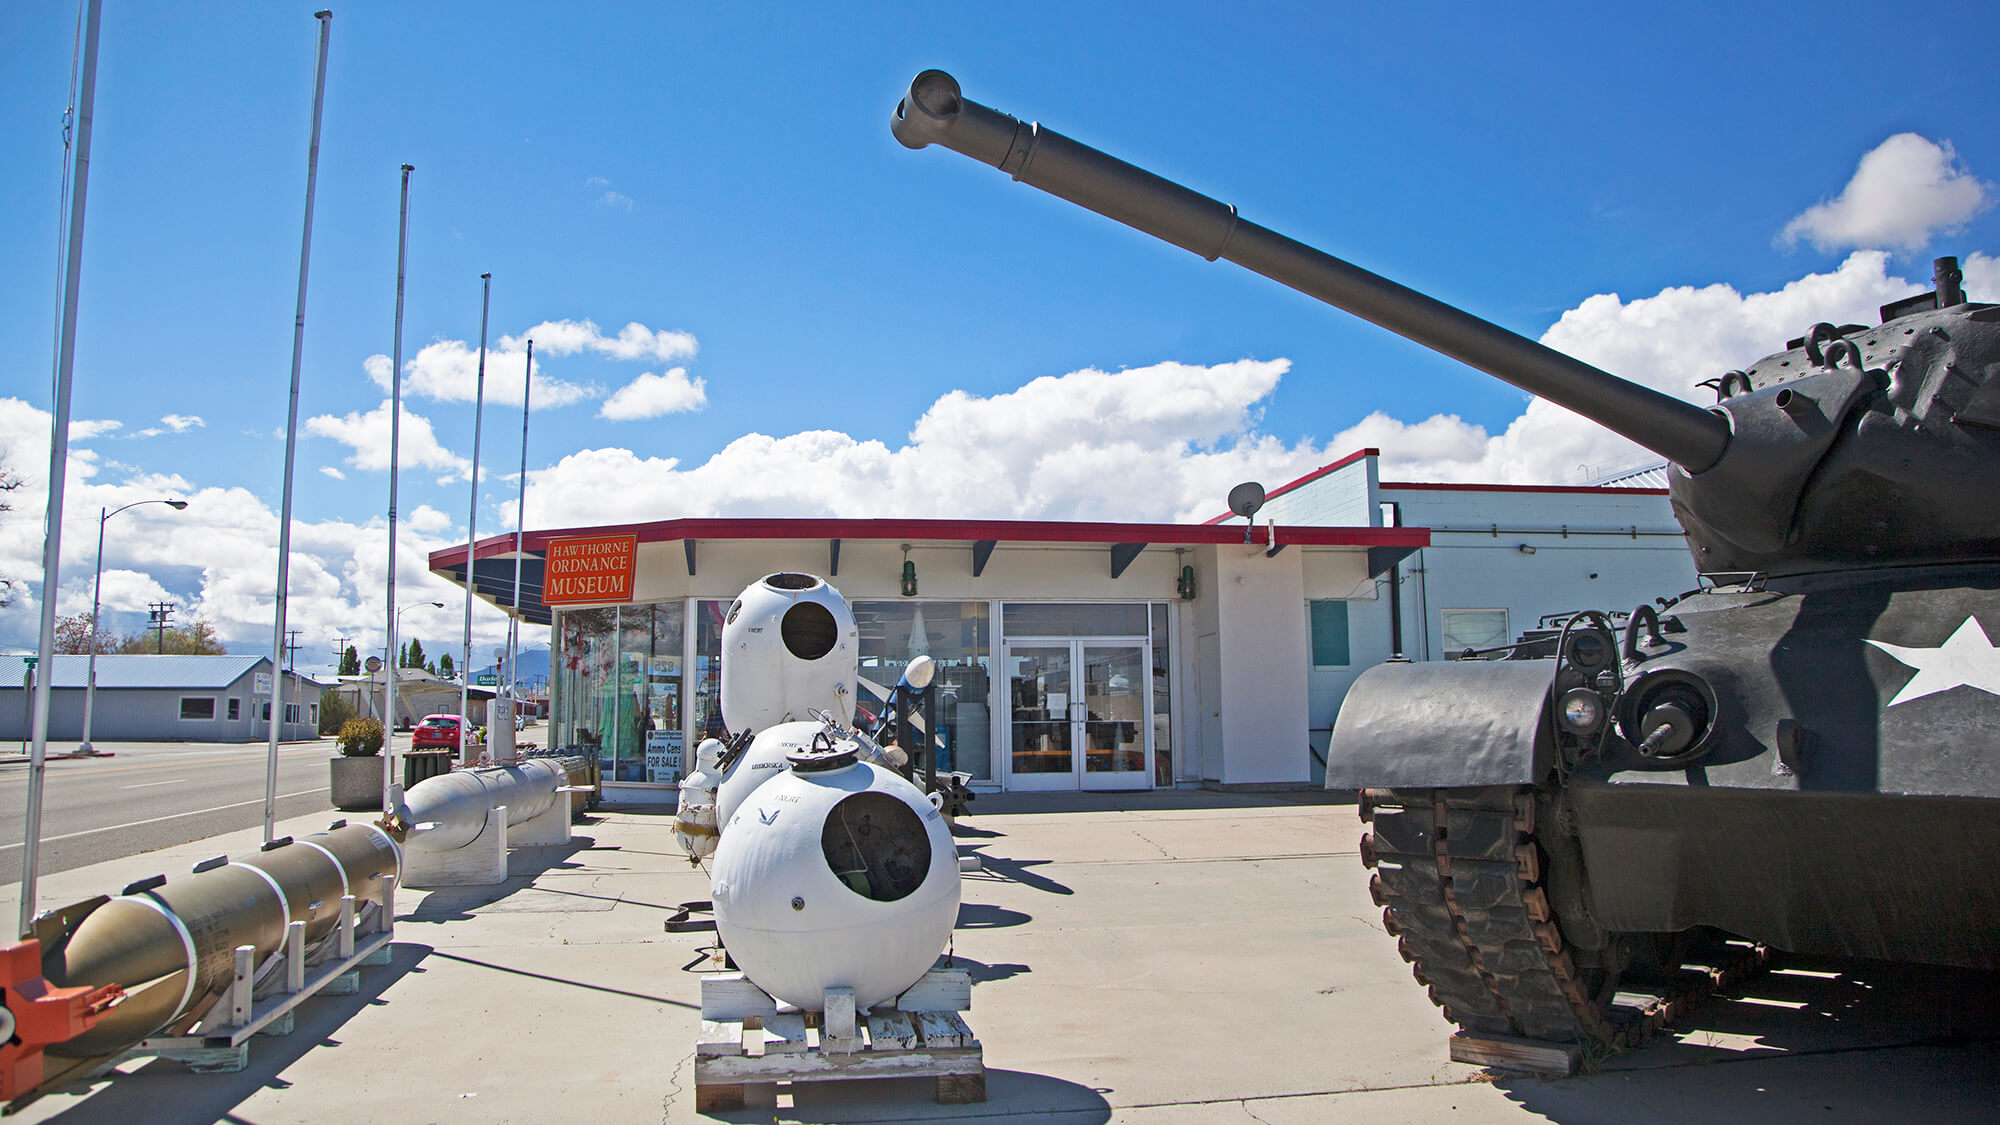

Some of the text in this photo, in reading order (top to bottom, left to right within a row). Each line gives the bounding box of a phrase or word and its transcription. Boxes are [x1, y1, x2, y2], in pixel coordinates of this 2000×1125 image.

[553, 541, 629, 557] HAWTHORNE
[551, 556, 628, 574] ORDNANCE
[549, 575, 625, 596] MUSEUM
[648, 742, 681, 754] Ammo Cans
[647, 756, 660, 768] FOR
